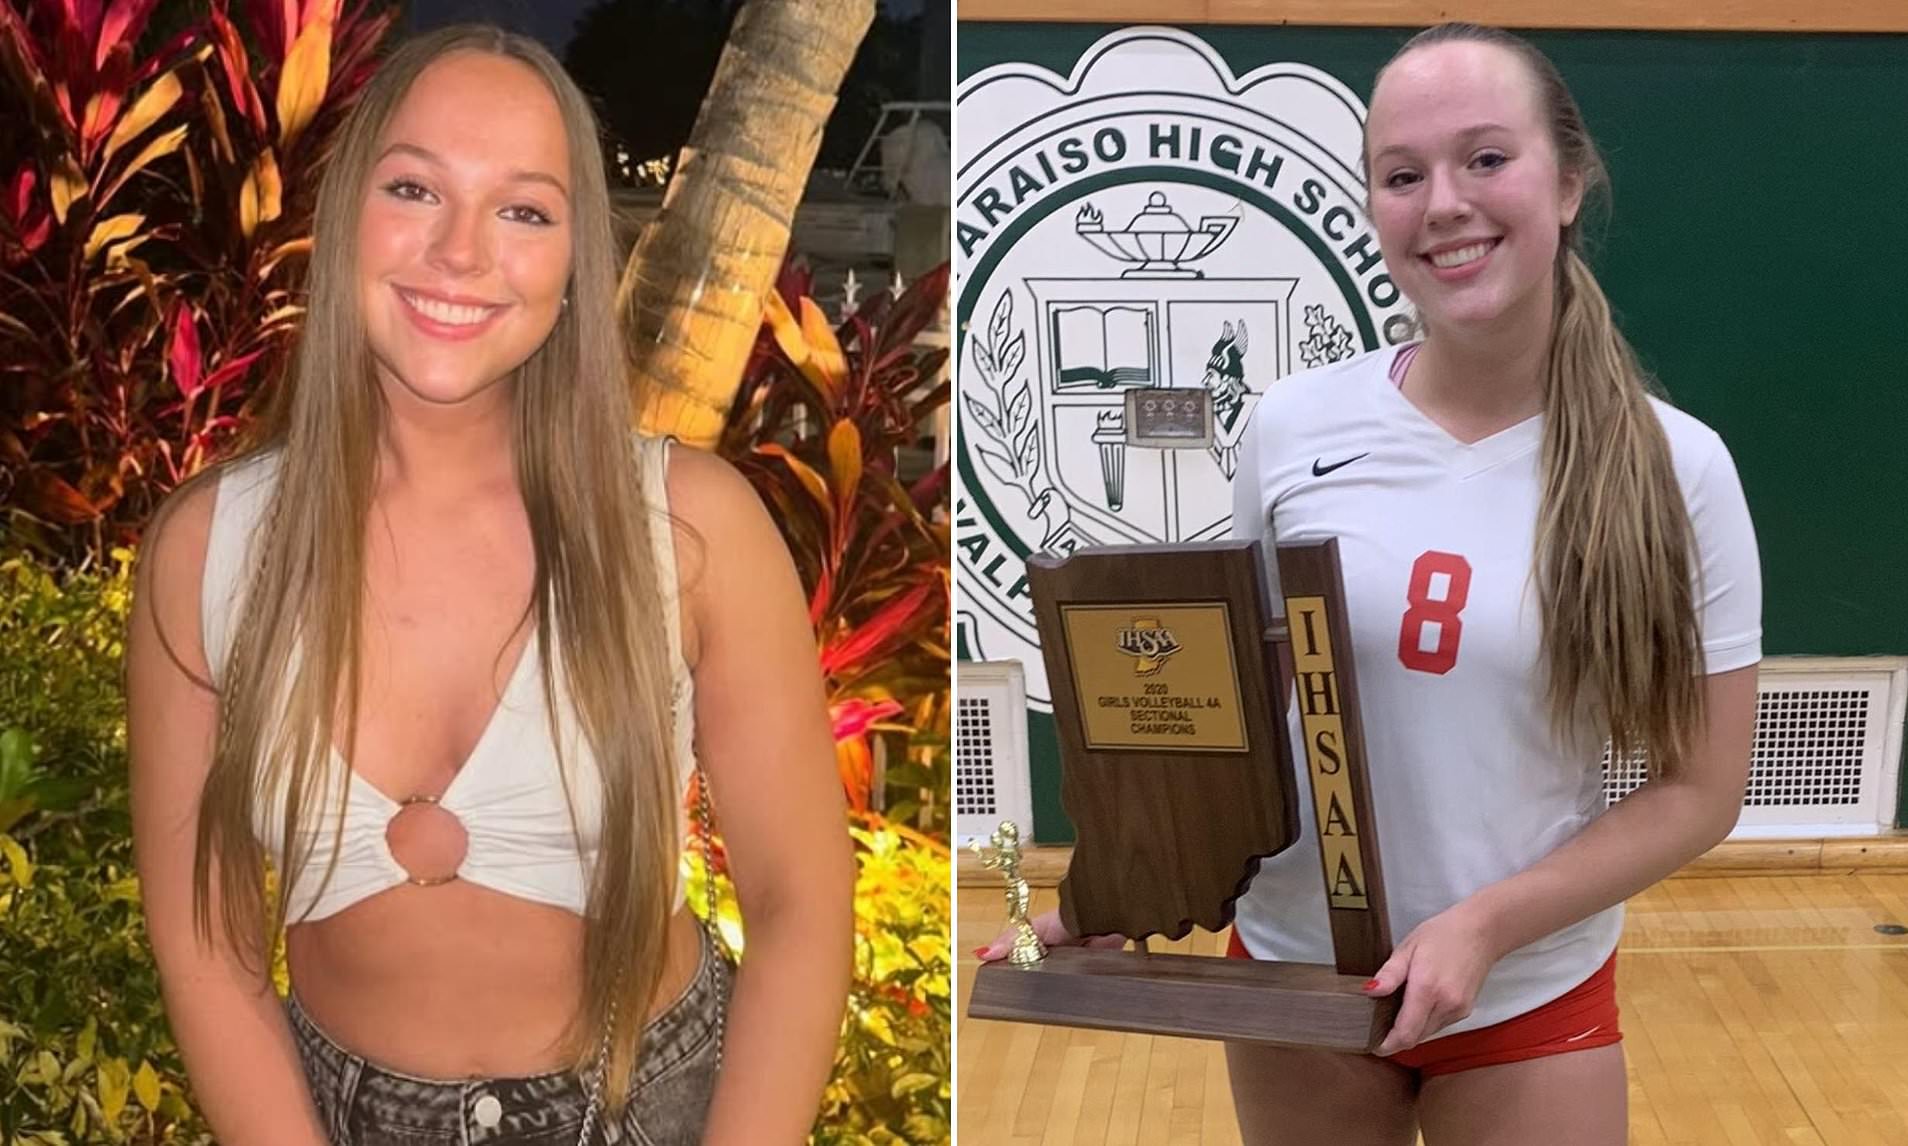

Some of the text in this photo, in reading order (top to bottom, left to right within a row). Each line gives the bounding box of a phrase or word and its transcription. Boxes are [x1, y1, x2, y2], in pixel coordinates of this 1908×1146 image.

[957, 123, 1415, 346] ARAISO HIGH SCHOO
[1397, 549, 1473, 676] 8
[1144, 683, 1169, 695] 2020
[1098, 696, 1222, 709] GIRLS VOLLEYBALL 4A
[1130, 709, 1193, 722] SECTIONAL
[1130, 723, 1196, 736] CHAMPIONS
[1300, 609, 1366, 898] IHSAA
